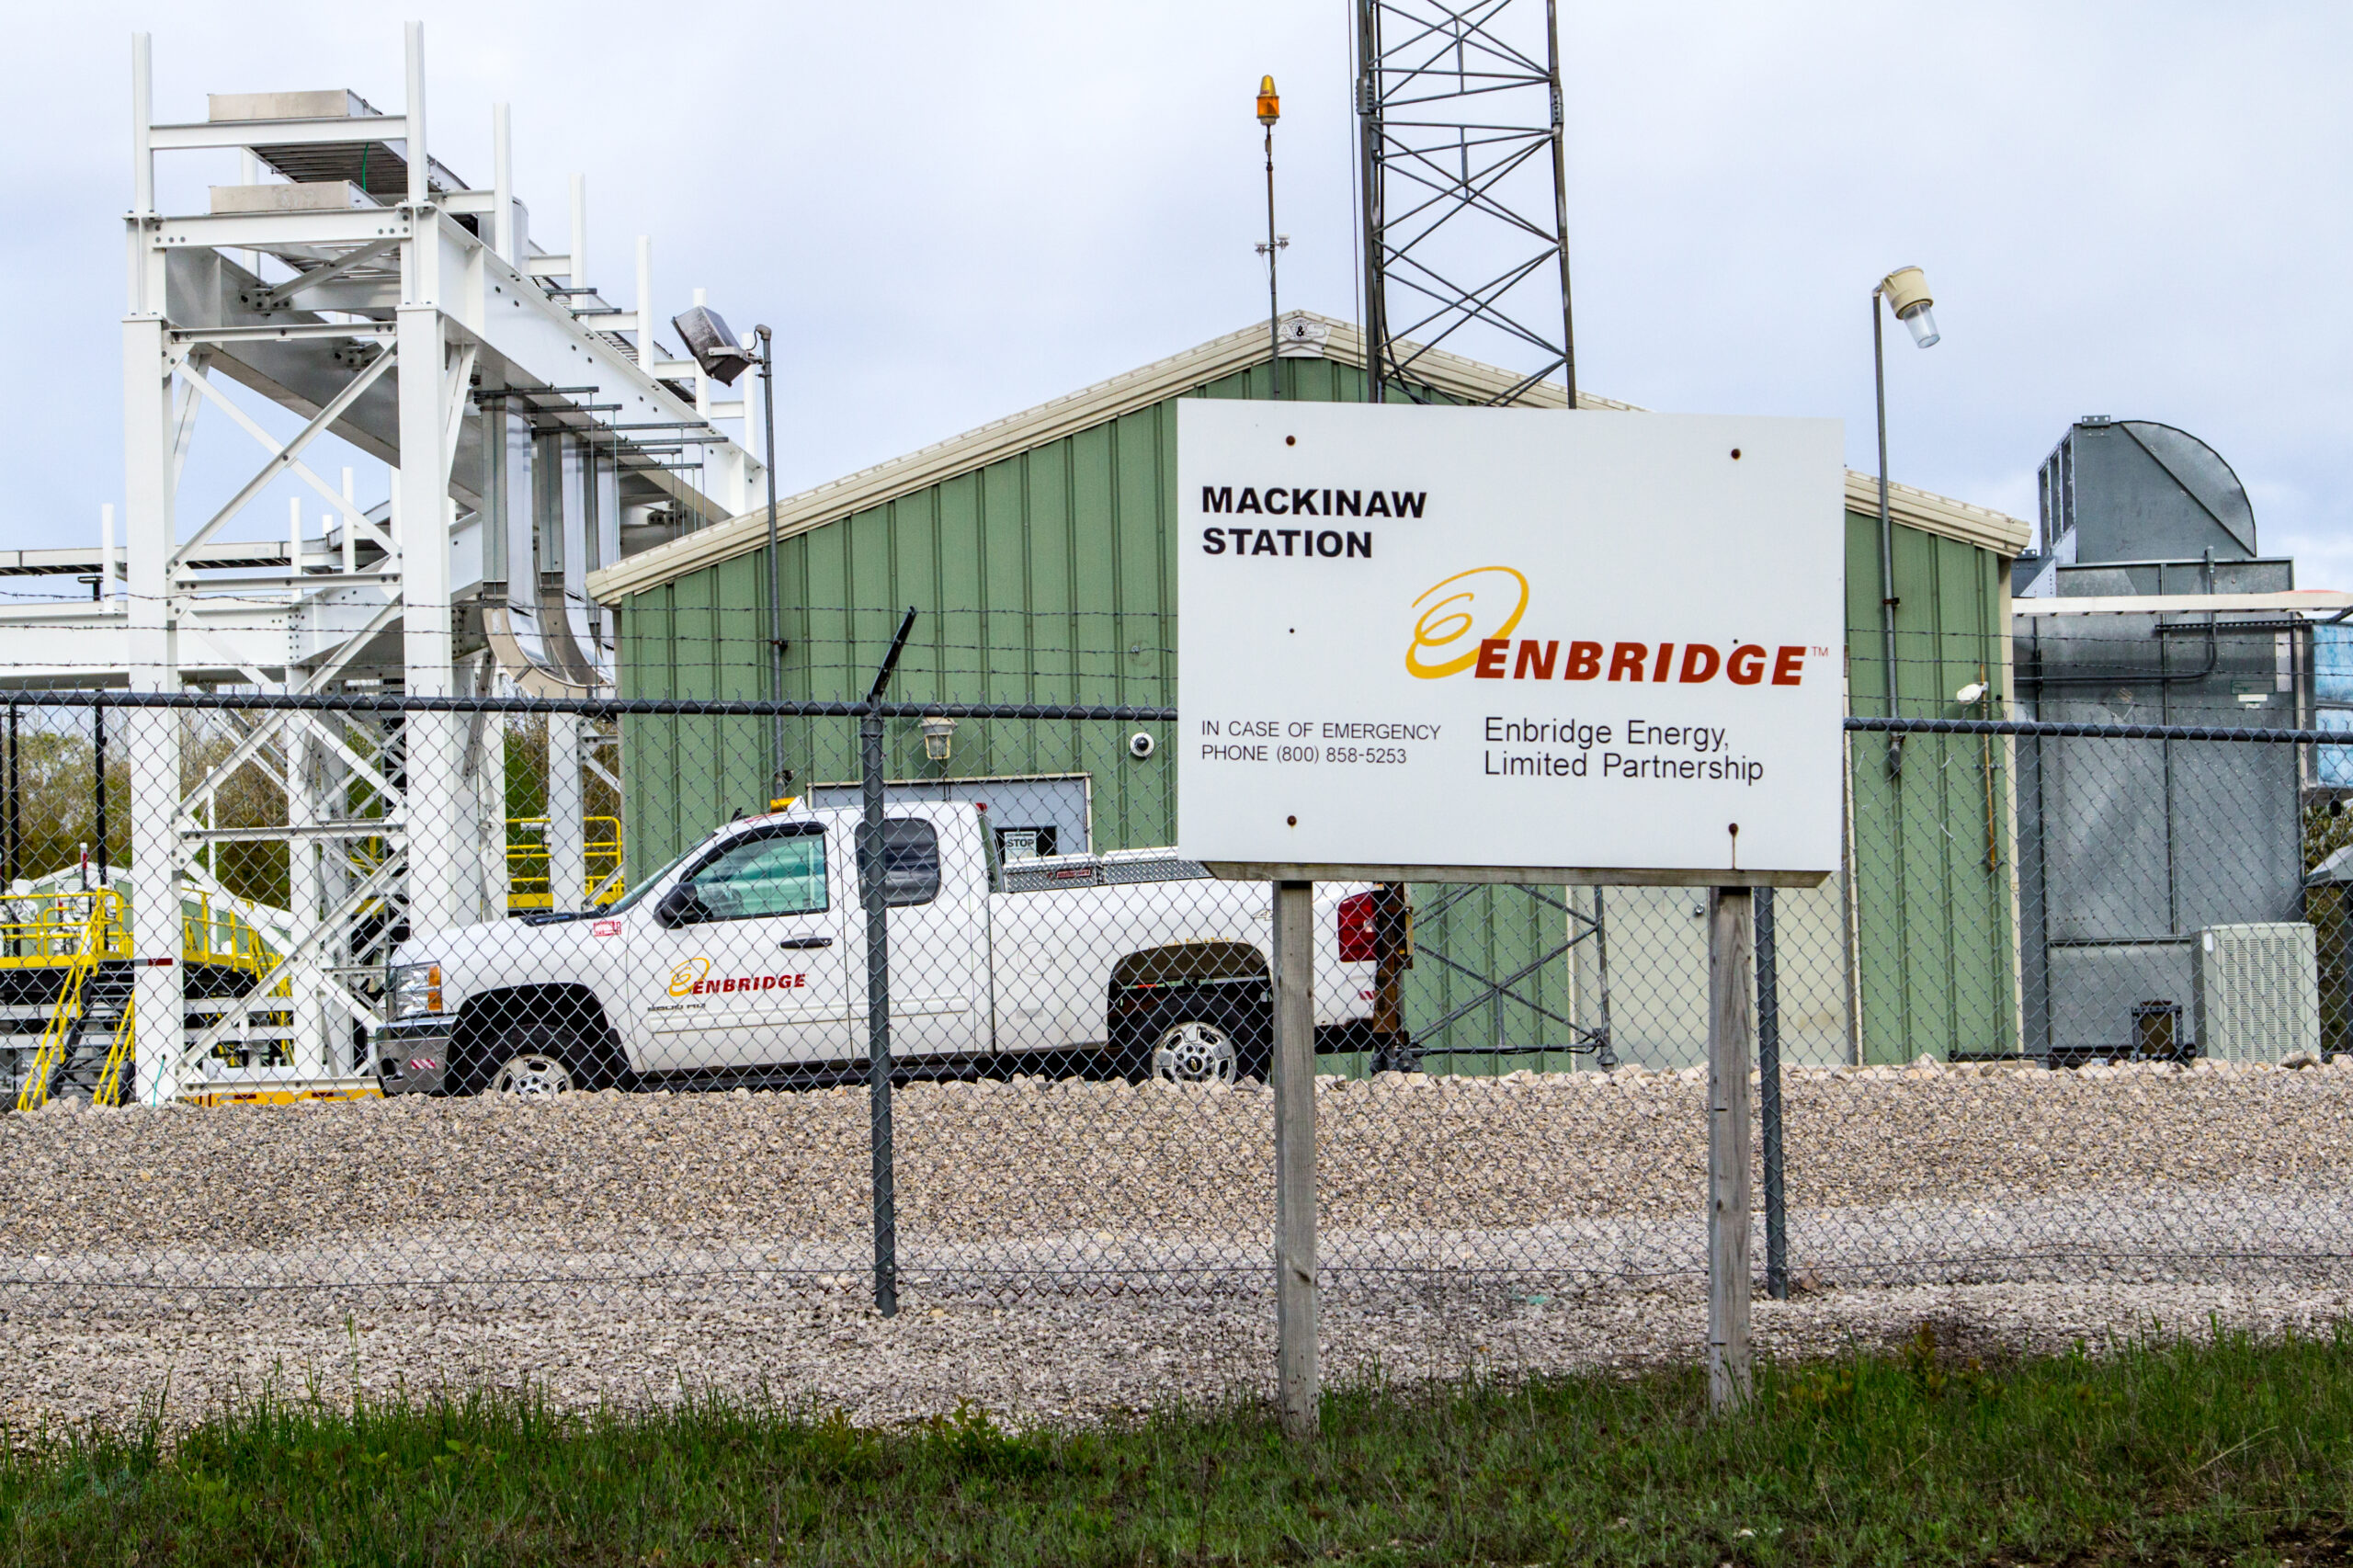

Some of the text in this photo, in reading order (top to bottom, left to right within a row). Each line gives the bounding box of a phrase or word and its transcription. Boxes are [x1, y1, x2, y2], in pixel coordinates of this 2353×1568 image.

[1202, 485, 1427, 519] MACKINAW
[1202, 527, 1372, 559] STATION
[1474, 638, 1807, 686] ENBRIDGE
[1201, 720, 1441, 741] IN CASE OF EMERGENCY
[1484, 716, 1729, 753] Enbridge Energy,
[1201, 744, 1407, 765] PHONE (800) 858-5253
[1484, 750, 1764, 787] Limited Partnership
[1006, 838, 1035, 847] STOP
[692, 973, 806, 995] ENBRIDGE
